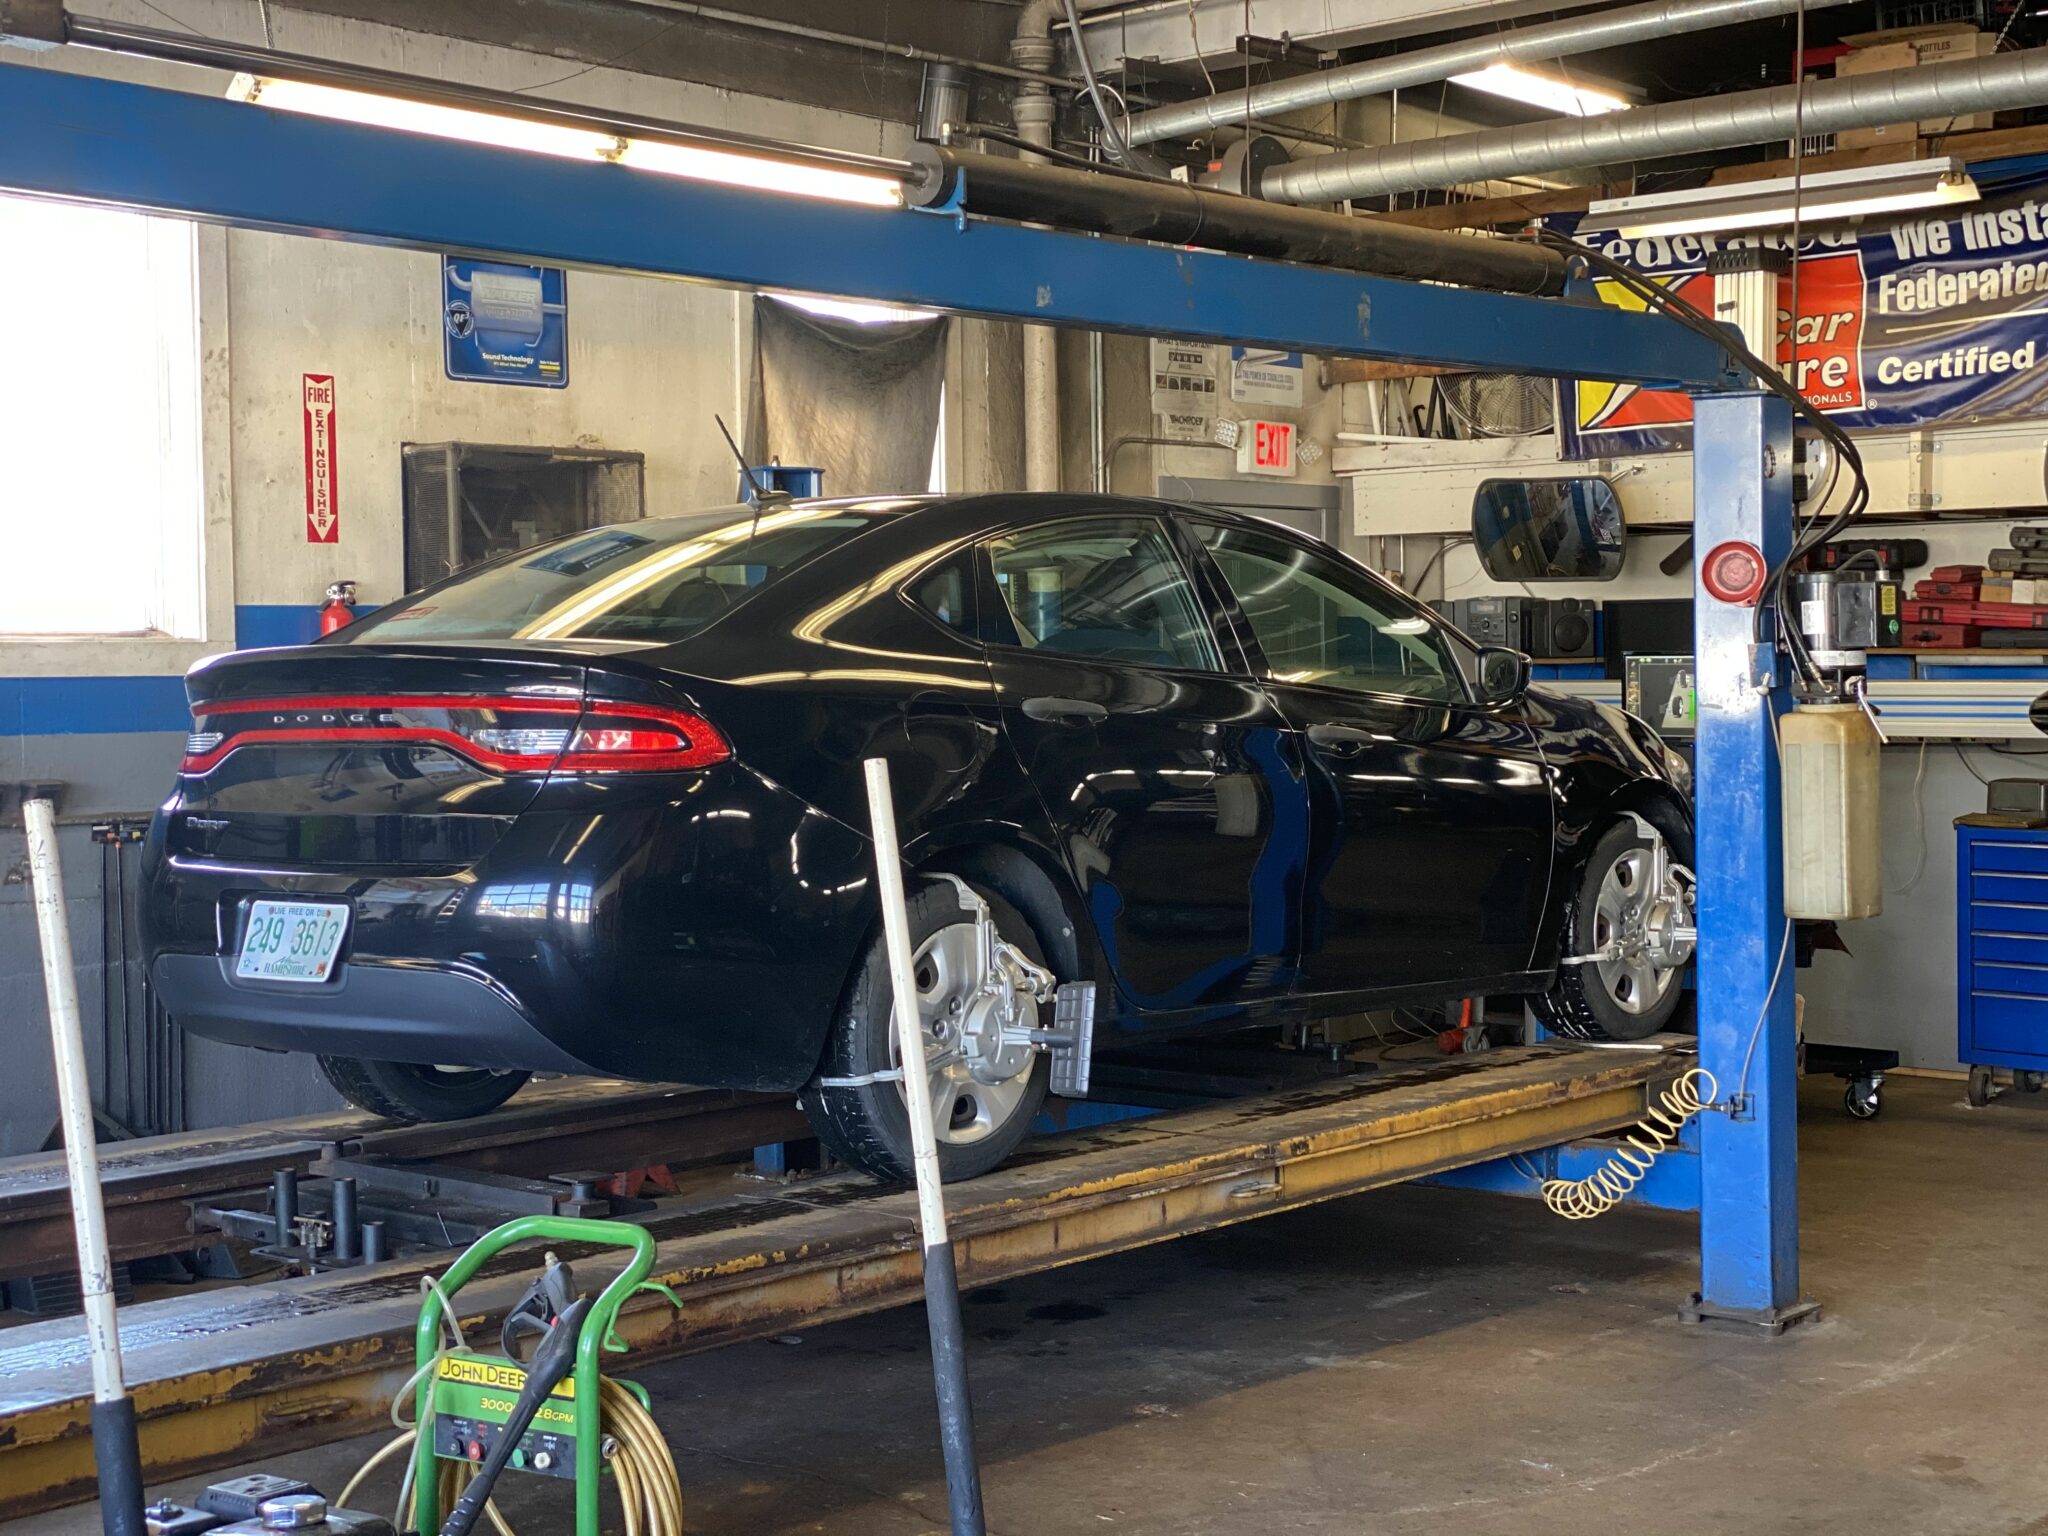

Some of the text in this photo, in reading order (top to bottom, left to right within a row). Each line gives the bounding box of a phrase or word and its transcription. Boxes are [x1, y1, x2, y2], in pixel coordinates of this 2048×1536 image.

[1890, 219, 1951, 260] We
[1777, 311, 1854, 345] Car
[482, 353, 501, 361] Sound
[501, 354, 534, 364] Technology
[1777, 356, 1848, 390] re
[1877, 340, 2035, 385] Certified
[307, 387, 331, 403] FIRE
[1804, 391, 1852, 405] IONALS
[1256, 423, 1290, 467] EXIT
[315, 409, 327, 528] EXTINGUISHER
[273, 713, 393, 724] DODGE
[288, 907, 304, 916] FREE
[246, 917, 339, 956] 249 3613
[264, 961, 307, 976] HAMPSHIRE
[443, 1358, 527, 1388] JOHN DEER
[480, 1397, 515, 1413] 3000
